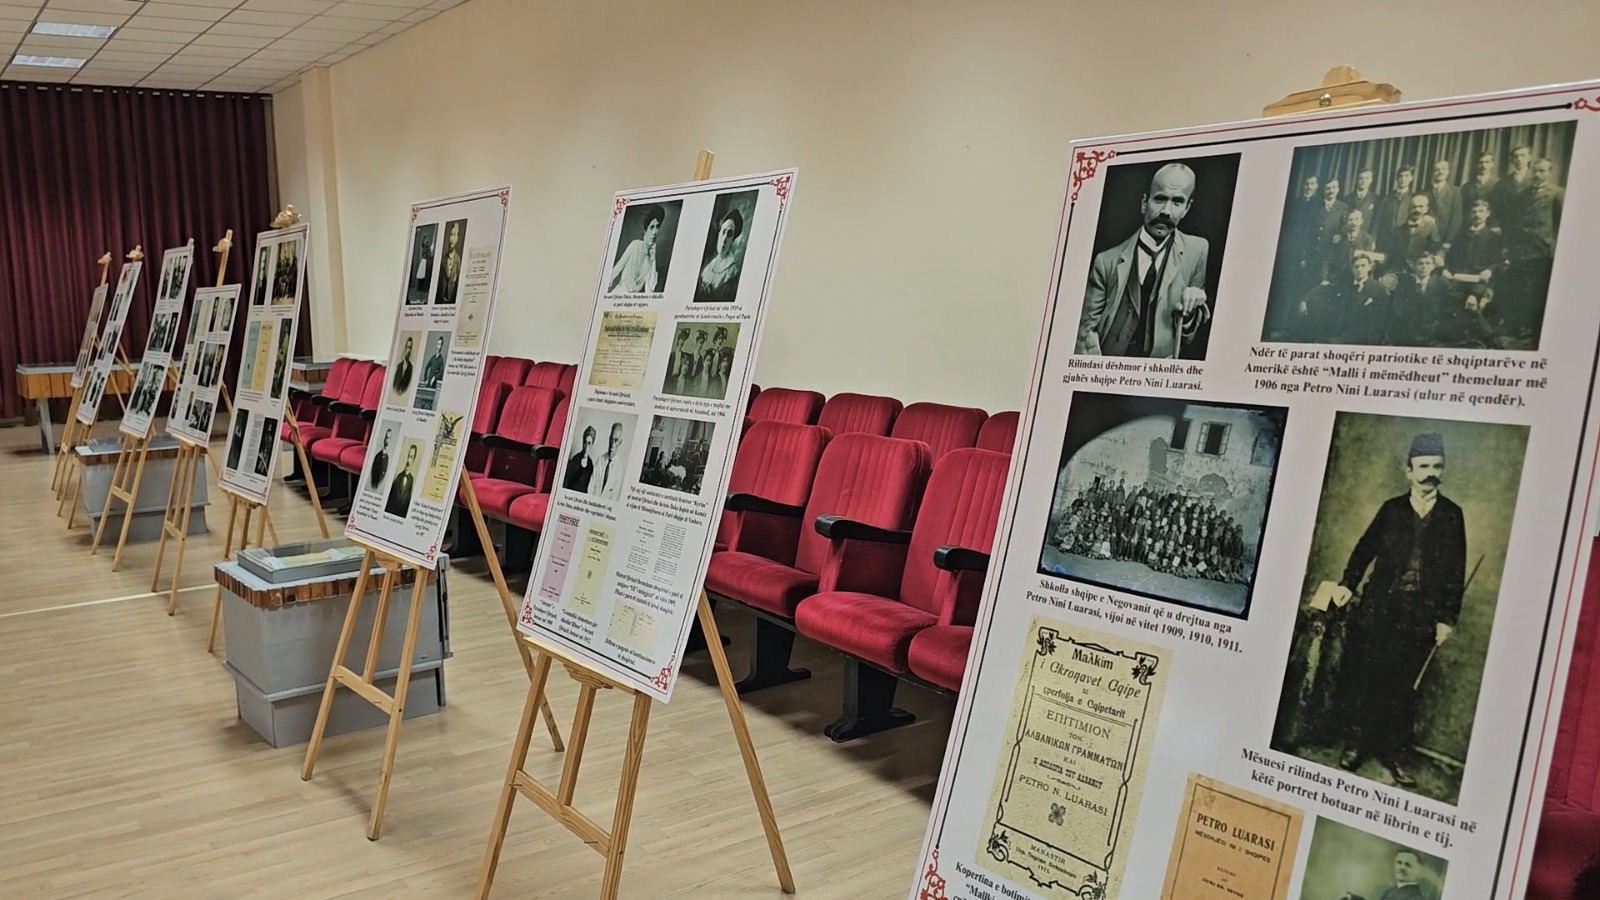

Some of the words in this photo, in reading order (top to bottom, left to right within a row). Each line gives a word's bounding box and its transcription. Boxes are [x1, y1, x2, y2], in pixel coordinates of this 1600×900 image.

[1068, 359, 1103, 369] Rilindasi
[1105, 360, 1142, 371] dëshmor
[1149, 363, 1183, 374] shkollës
[1186, 366, 1203, 375] dhe
[1250, 346, 1276, 358] Ndër
[1278, 348, 1288, 359] të
[1290, 350, 1319, 361] parat
[1322, 350, 1365, 363] shoqëri
[1368, 353, 1428, 365] patriotike
[1432, 355, 1443, 365] të
[1447, 355, 1526, 370] shqiptarëve
[1530, 358, 1547, 370] në
[1062, 373, 1088, 384] gjuhës
[1090, 375, 1117, 386] shqipe
[1119, 376, 1142, 386] Petro
[1144, 378, 1163, 388] Nini
[1165, 380, 1203, 391] Luarasi.
[1244, 363, 1289, 374] Amerikë
[1292, 365, 1319, 376] është
[1322, 367, 1359, 378] “Malli
[1452, 373, 1522, 388] themeluar
[1526, 378, 1548, 389] më
[1254, 379, 1278, 390] 1906
[1280, 383, 1299, 393] nga
[1303, 382, 1332, 393] Petro
[1336, 384, 1360, 395] Nini
[1364, 386, 1410, 399] Luarasi
[1414, 389, 1446, 402] (ulur
[1450, 392, 1465, 403] në
[1468, 394, 1526, 408] qendër).
[1026, 590, 1049, 604] Petro
[1049, 596, 1067, 609] Nini
[1068, 600, 1102, 619] Luarasi,
[1104, 610, 1124, 624] vijoi
[1125, 616, 1137, 627] në
[1139, 619, 1158, 632] vitet
[1161, 623, 1186, 641] 1909,
[1189, 630, 1214, 647] 1910,
[1217, 637, 1243, 653] 1911.
[1039, 579, 1069, 596] Shkolla
[1071, 587, 1098, 602] shqipe
[1107, 594, 1151, 614] Negovanit
[1153, 606, 1165, 618] që
[1167, 611, 1173, 619] u
[1176, 611, 1211, 628] drejtua
[1214, 620, 1232, 634] nga
[1019, 774, 1049, 792] PETRO
[1065, 792, 1108, 816] LUARASI
[1241, 747, 1286, 772] Mësuesi
[1288, 760, 1332, 787] rilindas
[1336, 778, 1369, 799] Petro
[1372, 790, 1401, 809] Nini
[1403, 800, 1456, 827] Luarasi
[1459, 818, 1477, 834] në
[1251, 769, 1275, 787] këtë
[1276, 777, 1319, 802] portret
[1321, 792, 1363, 816] botuar
[1365, 806, 1381, 822] në
[1382, 812, 1420, 836] librin
[1424, 829, 1431, 839] e
[1434, 831, 1453, 848] tij.
[1196, 812, 1228, 833] PETRO
[1232, 827, 1275, 851] LUARASI
[955, 861, 993, 888] Kopertina
